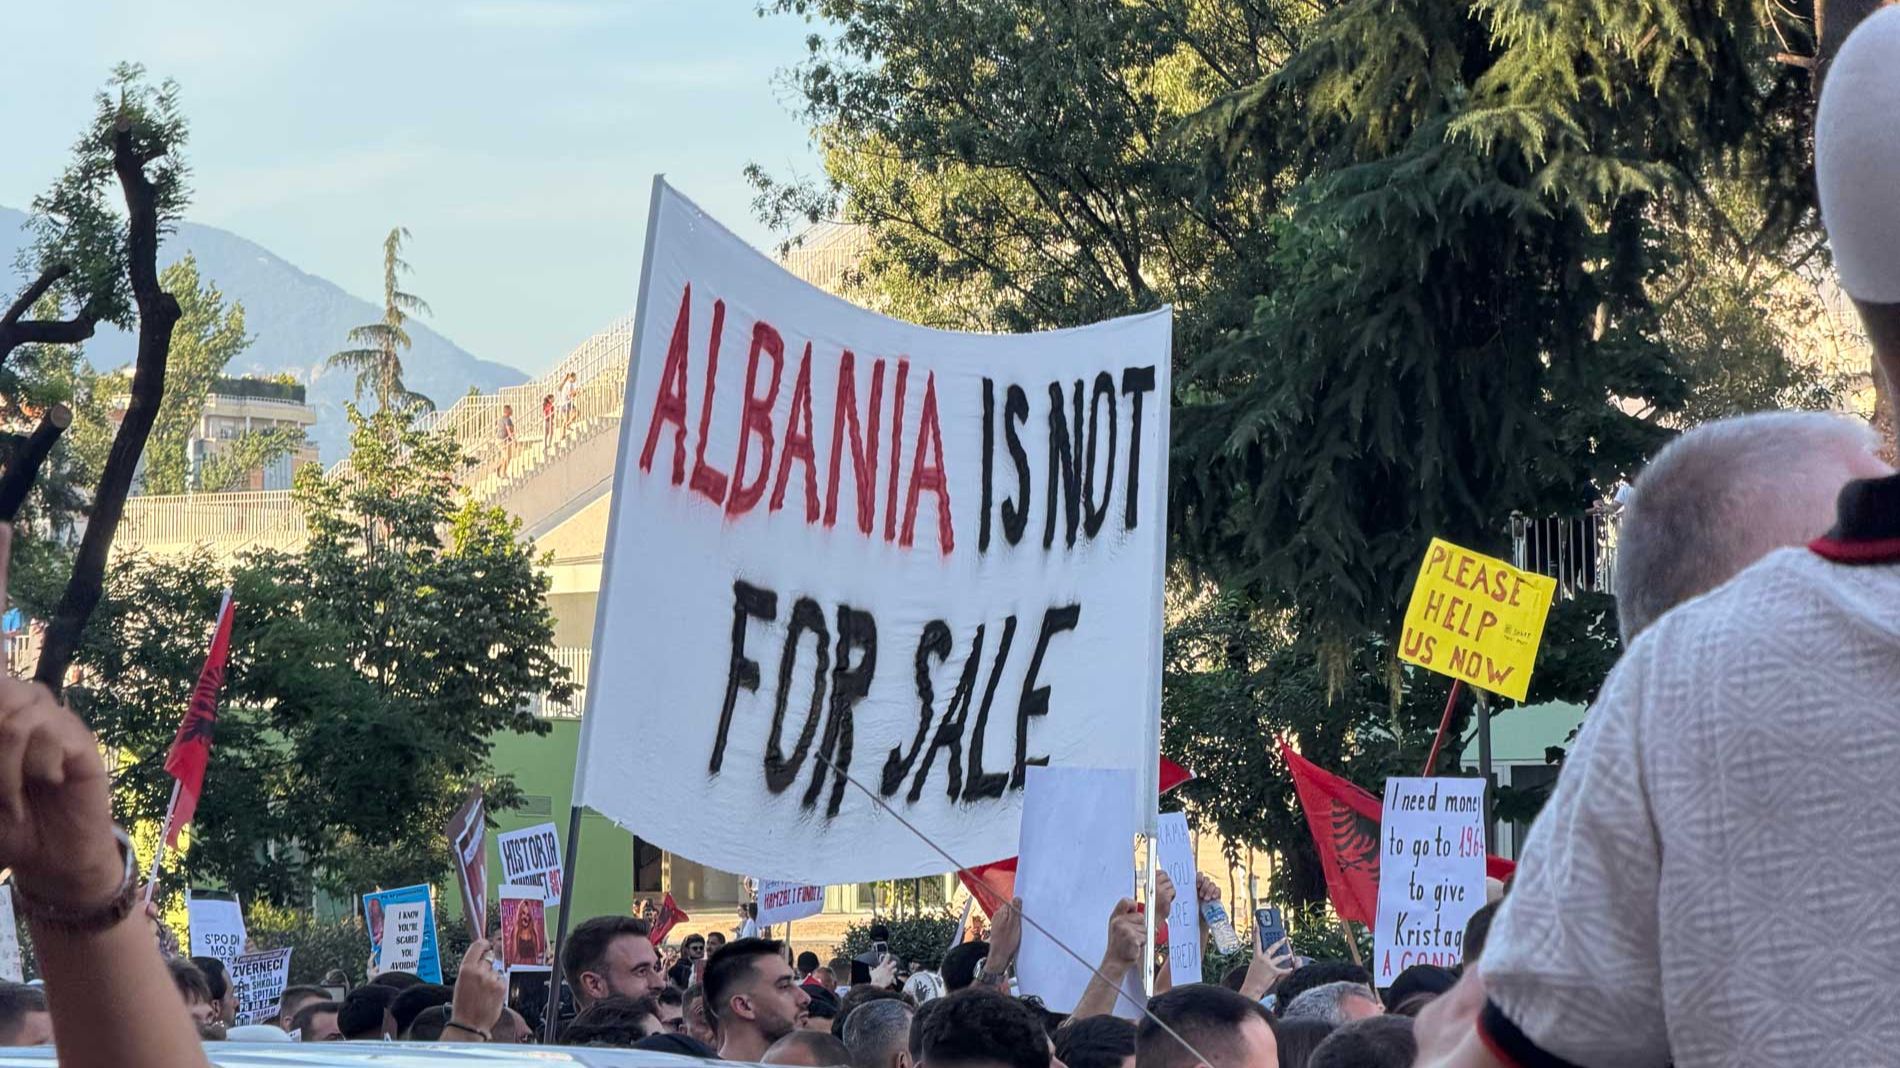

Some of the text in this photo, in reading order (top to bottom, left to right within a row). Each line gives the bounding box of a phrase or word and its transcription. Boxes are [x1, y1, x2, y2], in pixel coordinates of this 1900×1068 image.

[639, 281, 1155, 556] ALBANIA IS NOT
[1427, 545, 1526, 607] PLEASE
[1424, 590, 1498, 642] HELP
[1405, 627, 1515, 685] US NOW
[709, 579, 1081, 820] FOR SALE
[1391, 782, 1481, 823] I need money
[503, 831, 559, 876] HISTORIA
[1389, 826, 1404, 856] to
[1413, 838, 1429, 867] go
[1435, 826, 1450, 857] to
[1168, 862, 1190, 886] YOU
[1409, 870, 1465, 911] to give
[402, 910, 419, 919] KNOW
[1169, 902, 1191, 928] ARE
[211, 945, 236, 956] MO SI
[230, 934, 240, 946] DI
[396, 935, 418, 945] SCARED
[401, 949, 413, 957] YOU
[232, 958, 284, 978] ZVERNECI
[1382, 950, 1391, 976] A
[252, 976, 283, 990] SHKOLLA
[252, 987, 281, 1001] SPITALE
